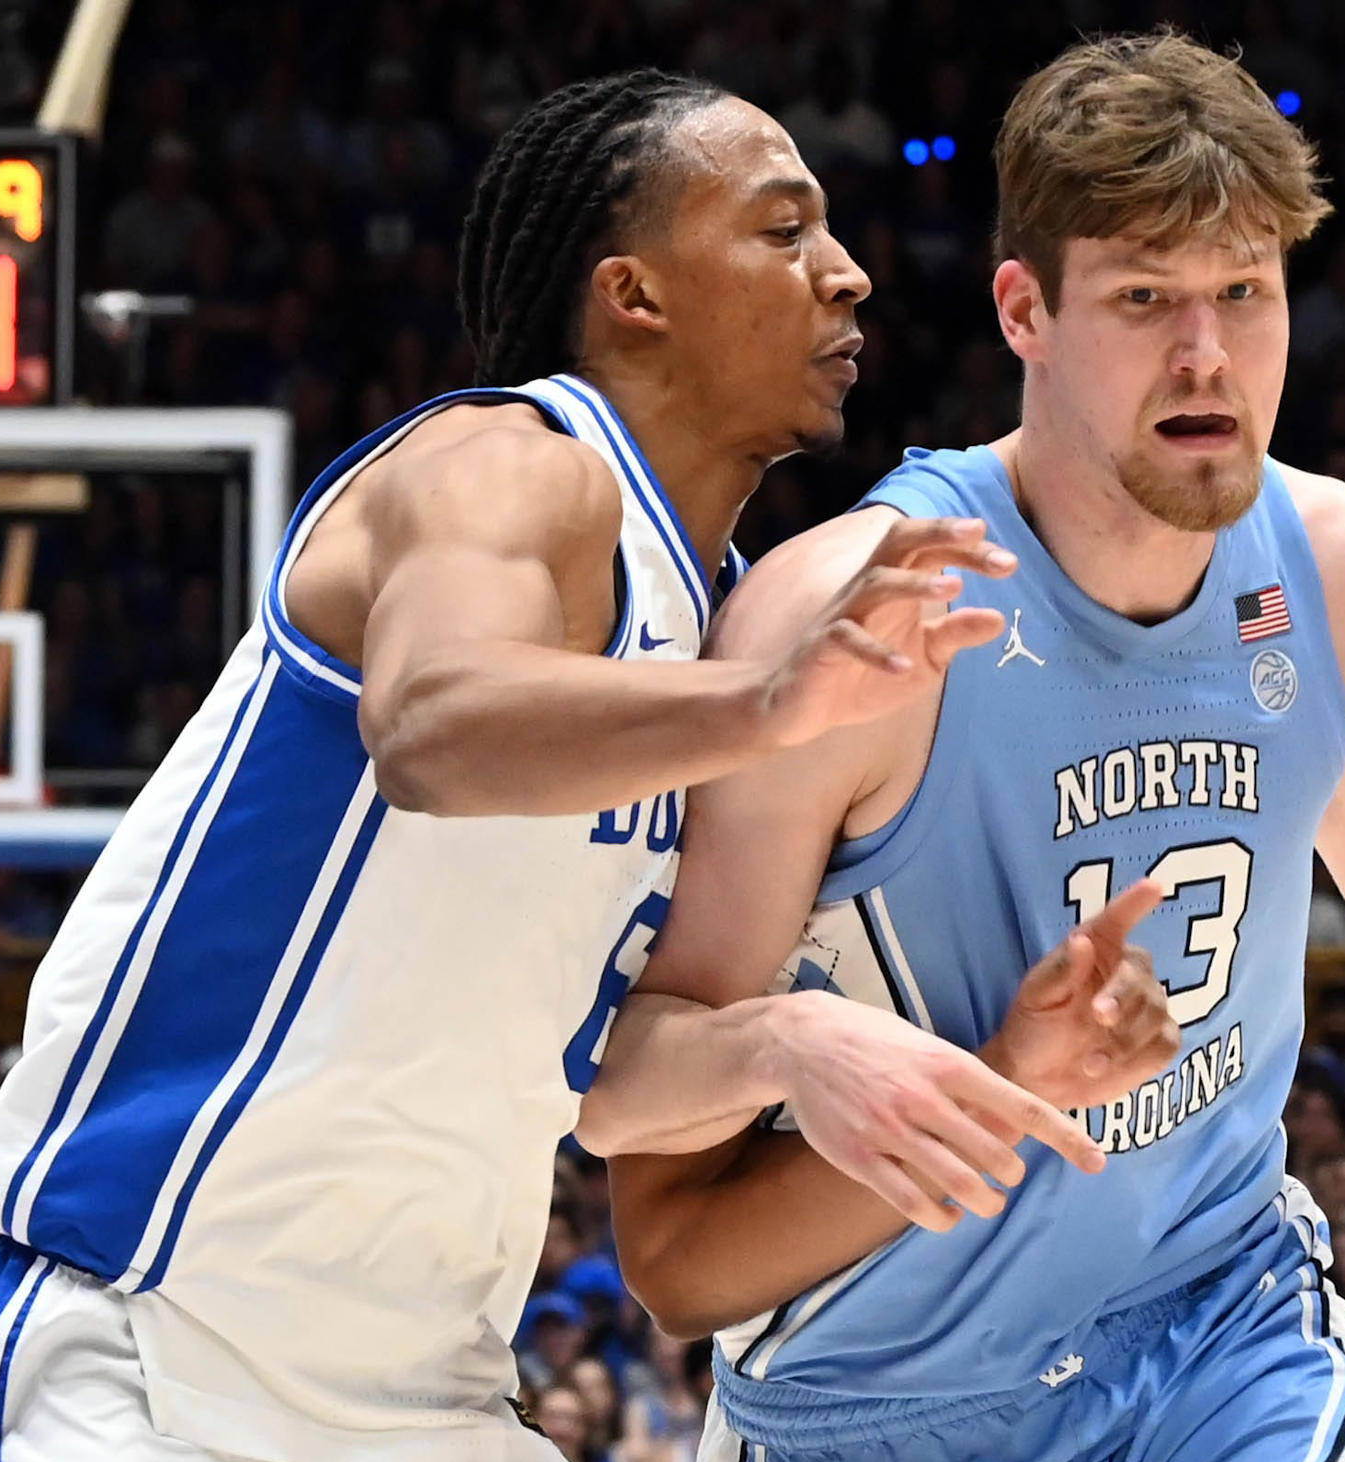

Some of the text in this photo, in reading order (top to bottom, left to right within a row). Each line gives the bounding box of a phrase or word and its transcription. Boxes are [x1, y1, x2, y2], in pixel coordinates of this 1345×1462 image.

[1259, 669, 1290, 687] ACC
[590, 789, 684, 852] DU
[1053, 738, 1259, 841] NORTH
